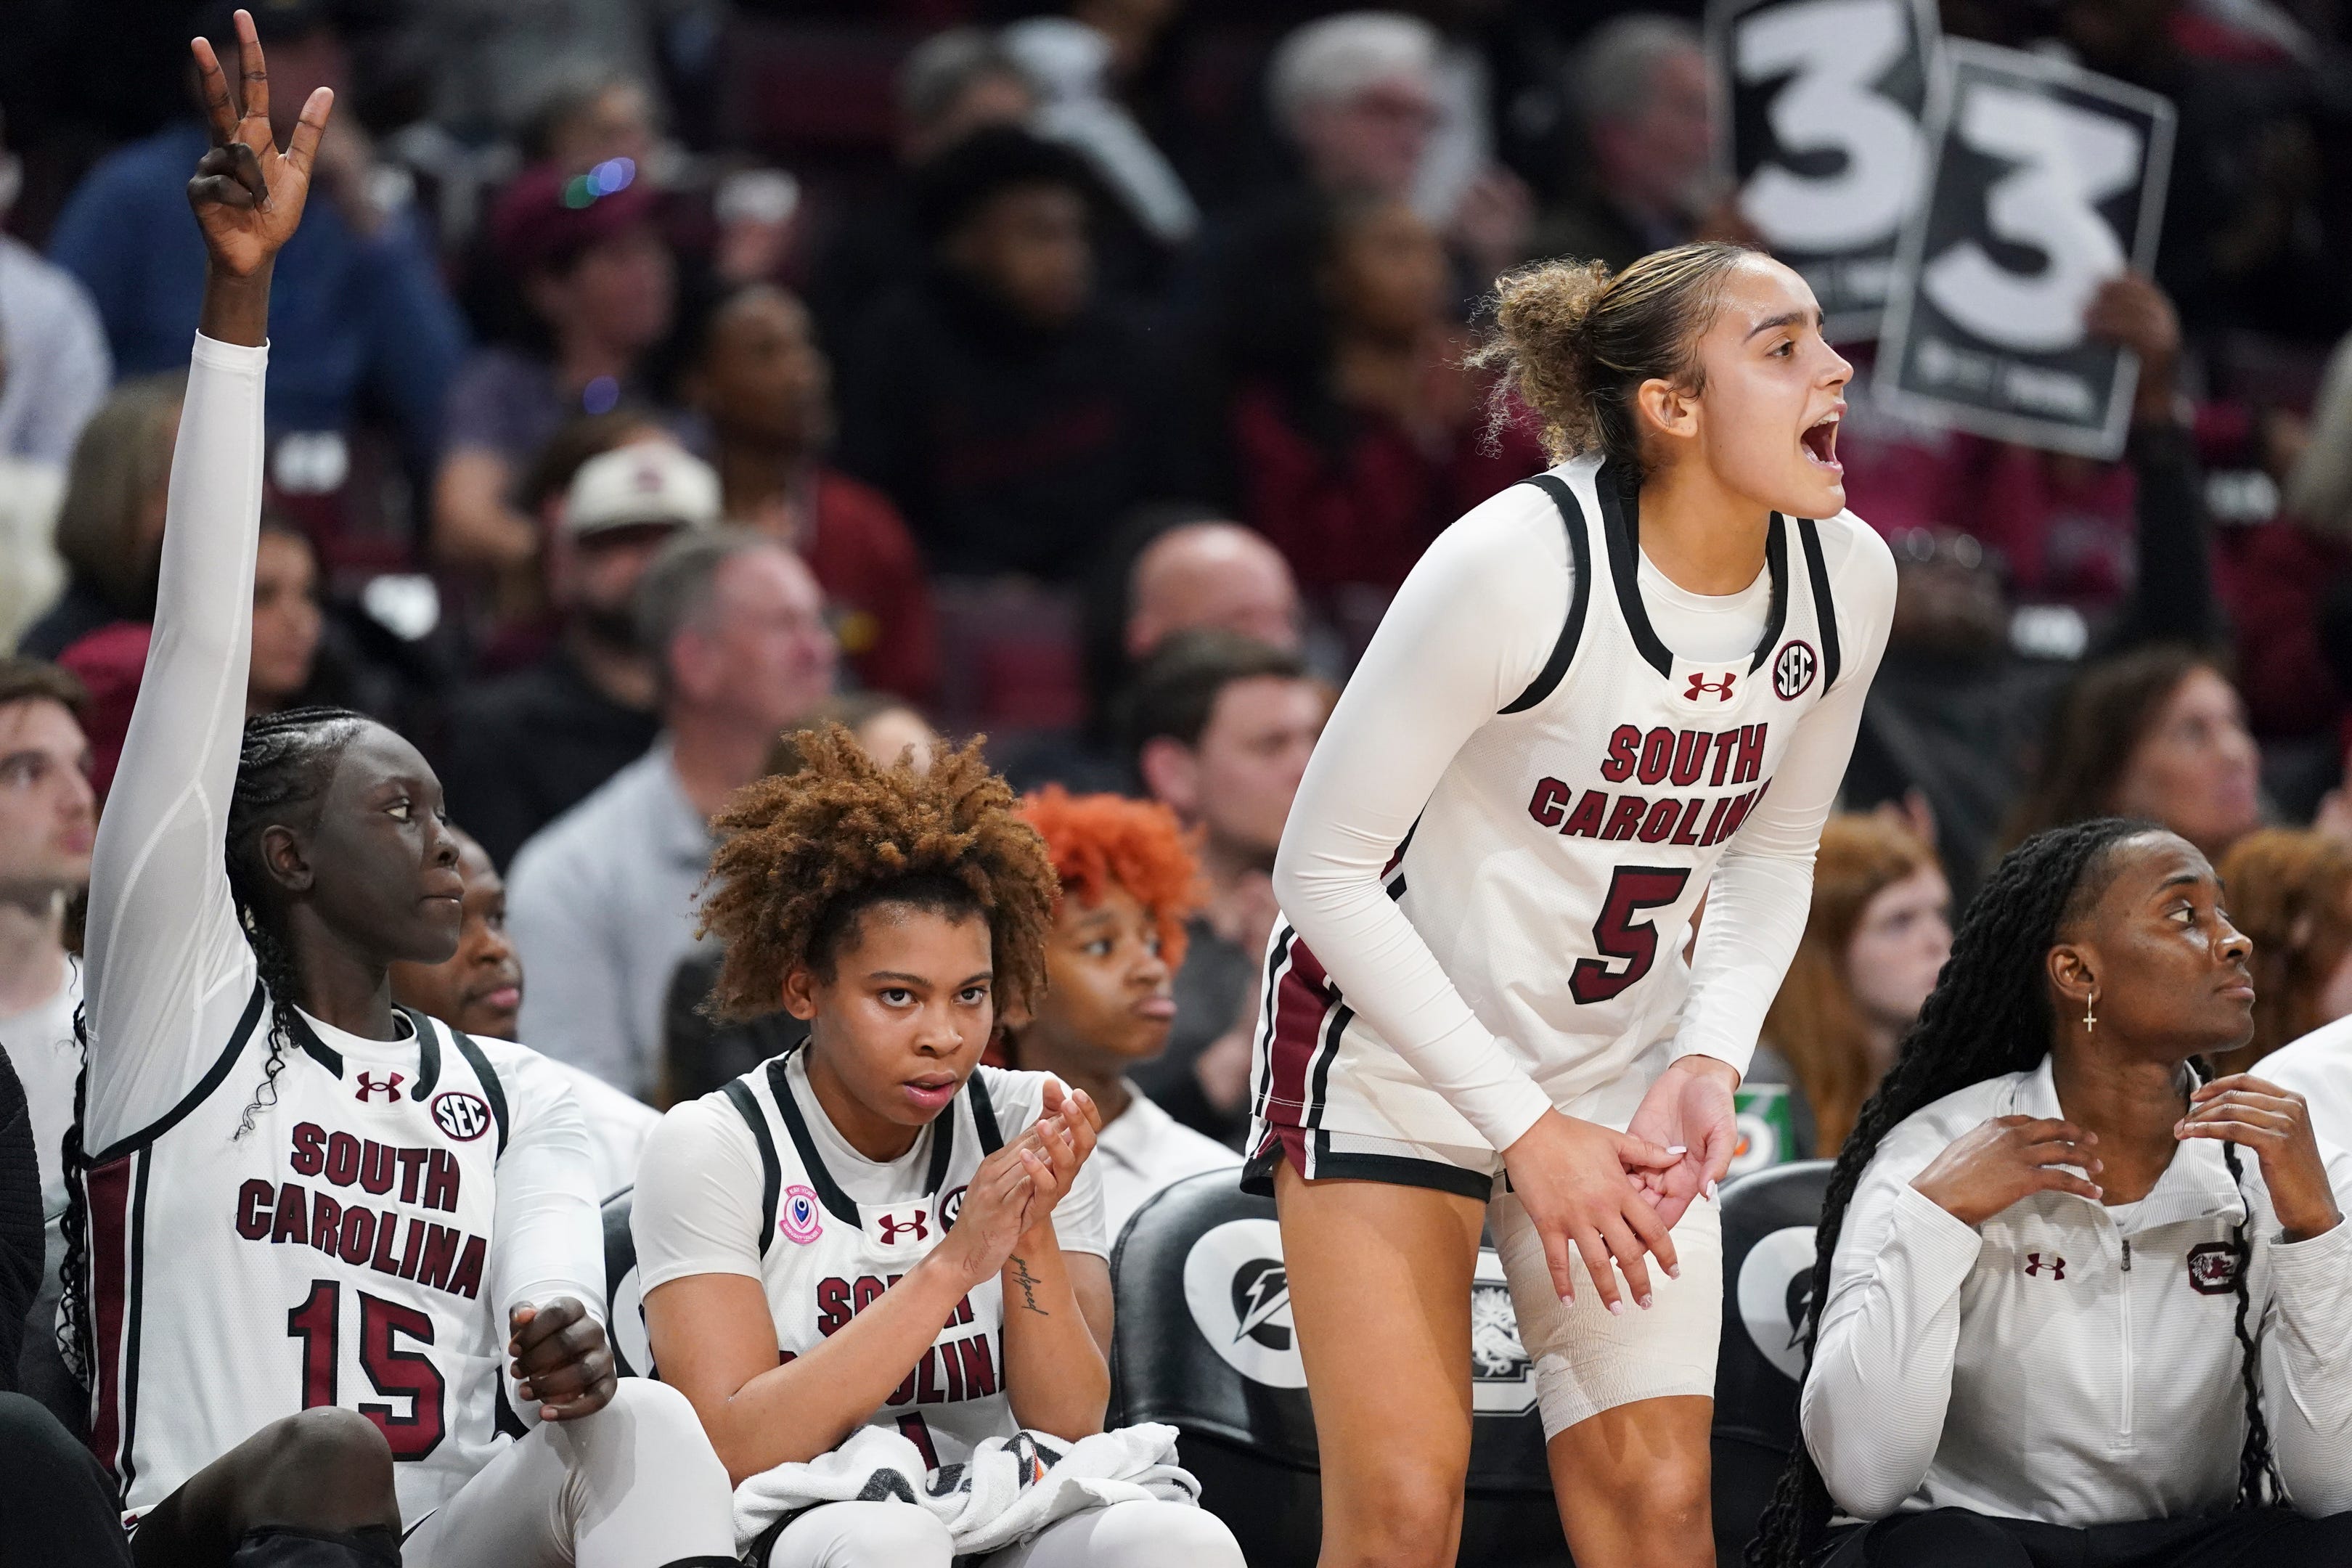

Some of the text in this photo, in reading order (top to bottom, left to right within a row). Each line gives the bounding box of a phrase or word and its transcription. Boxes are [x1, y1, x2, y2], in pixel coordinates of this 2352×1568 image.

[1736, 0, 1924, 251] 3
[1921, 81, 2143, 352] 3
[1777, 645, 1813, 697] SEC
[1600, 722, 1768, 787] SOUTH
[1528, 775, 1773, 847] CAROLIN
[1568, 865, 1692, 1005] 5
[290, 1122, 460, 1213] SOUTH
[436, 1095, 486, 1138] SEC
[235, 1178, 487, 1300] CAROLINA
[287, 1279, 445, 1461] 15
